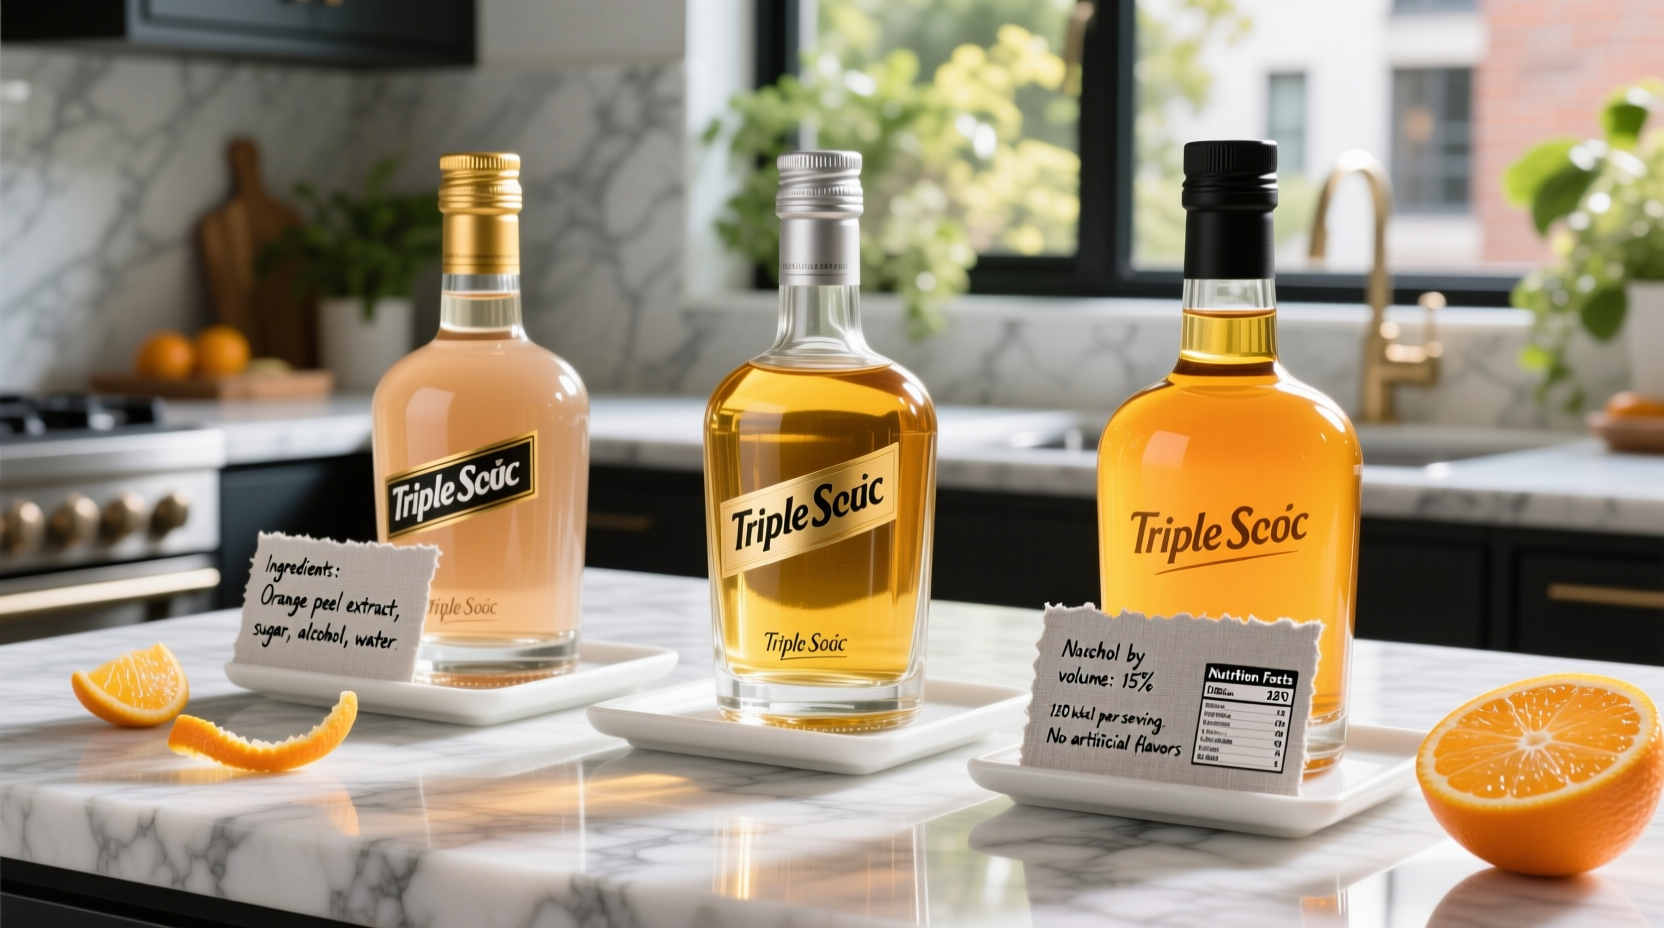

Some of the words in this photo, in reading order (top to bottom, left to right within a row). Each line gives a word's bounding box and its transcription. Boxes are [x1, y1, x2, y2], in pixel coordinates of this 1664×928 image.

[392, 473, 455, 522] Triple
[732, 496, 808, 552] Triple
[1131, 511, 1222, 564] Triple
[265, 554, 340, 582] Ingredients:
[261, 583, 308, 617] Orange
[310, 591, 344, 619] peel
[346, 597, 400, 622] extract,
[252, 623, 291, 648] sugar,
[298, 622, 349, 648] alcohol,
[1126, 643, 1145, 671] by
[1059, 666, 1114, 687] volume:
[1122, 671, 1155, 692] 15%
[1046, 727, 1067, 744] No
